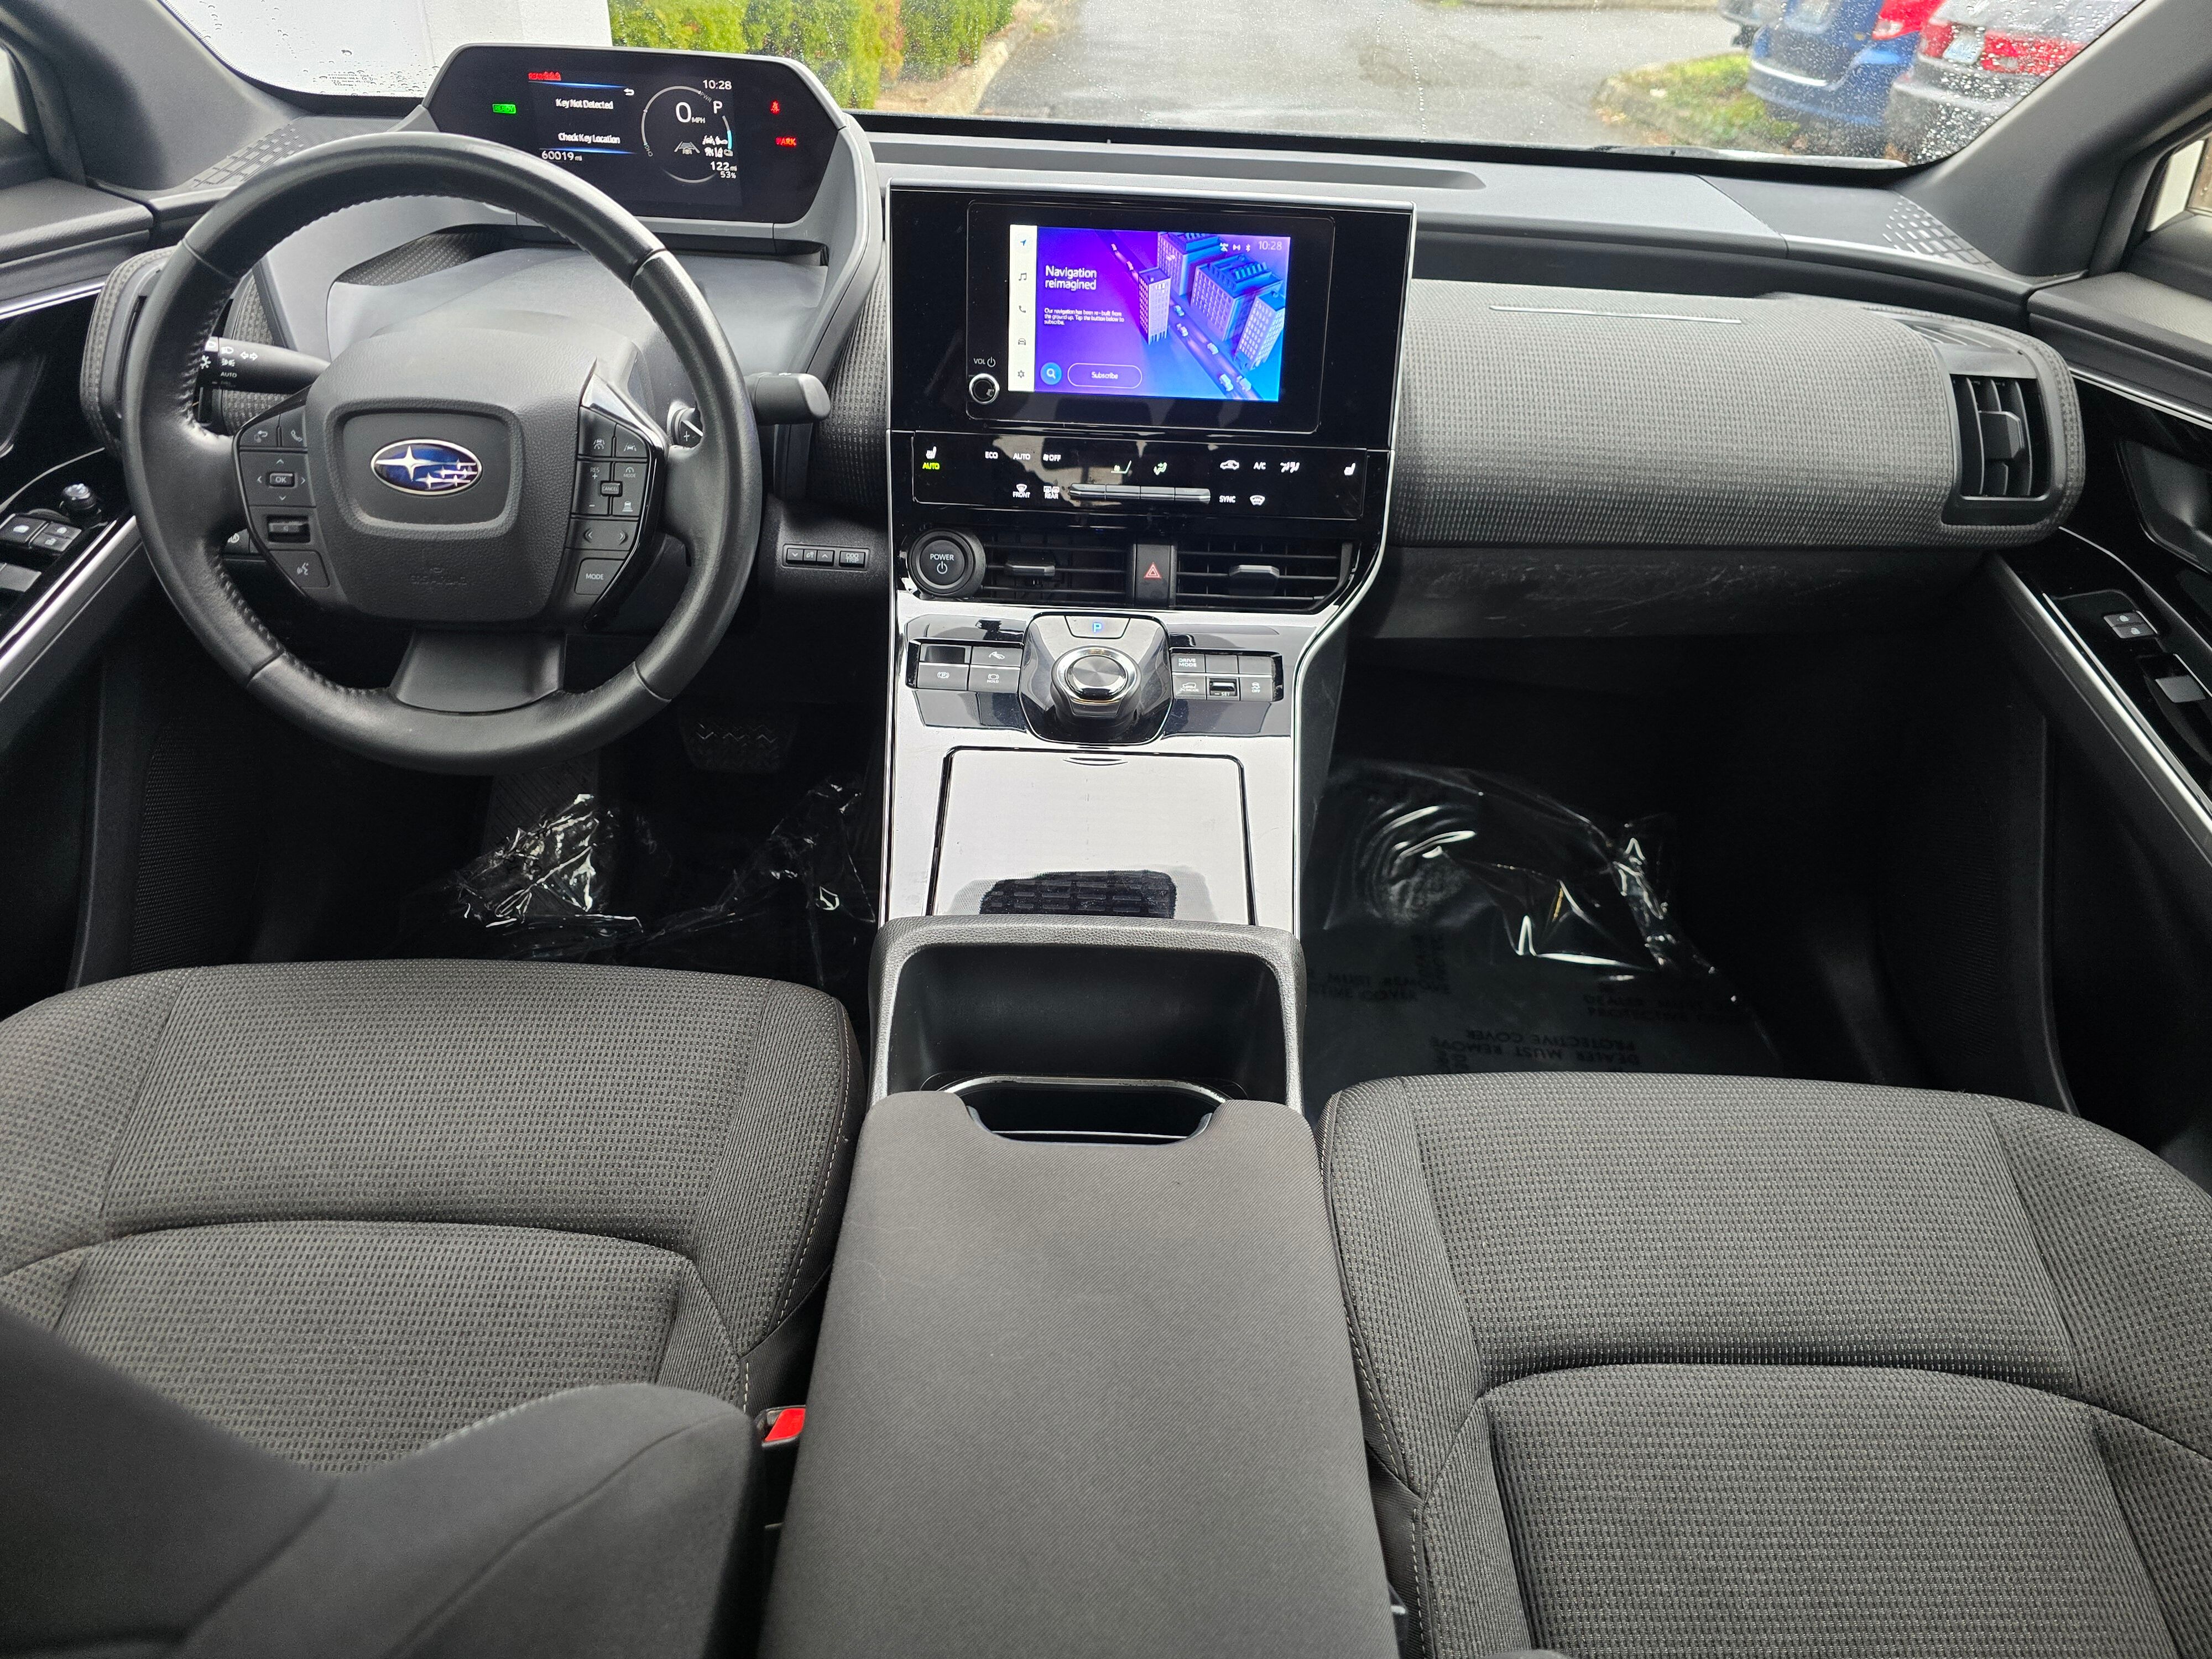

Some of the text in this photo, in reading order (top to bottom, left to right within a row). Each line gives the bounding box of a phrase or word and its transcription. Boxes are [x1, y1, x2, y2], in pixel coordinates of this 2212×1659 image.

[703, 79, 732, 90] 10:28
[700, 91, 712, 103] PWR
[555, 98, 614, 109] Key Not Detected
[713, 101, 723, 114] P
[676, 102, 691, 123] 0
[558, 132, 620, 144] Check Key Location
[776, 137, 796, 146] PARK
[541, 150, 574, 160] 60019
[711, 161, 730, 171] 122
[1259, 241, 1282, 251] 10:28
[1045, 265, 1097, 279] Navigation
[1045, 278, 1097, 291] reimagined
[1091, 371, 1118, 379] Subscribe
[985, 451, 999, 459] ECO
[1253, 461, 1266, 470] A/C
[1219, 495, 1236, 503] SYNC
[1093, 622, 1102, 633] P
[1465, 1029, 1523, 1044] COVER
[1430, 1036, 1503, 1055] REMOVE
[1515, 1045, 1562, 1060] MUST
